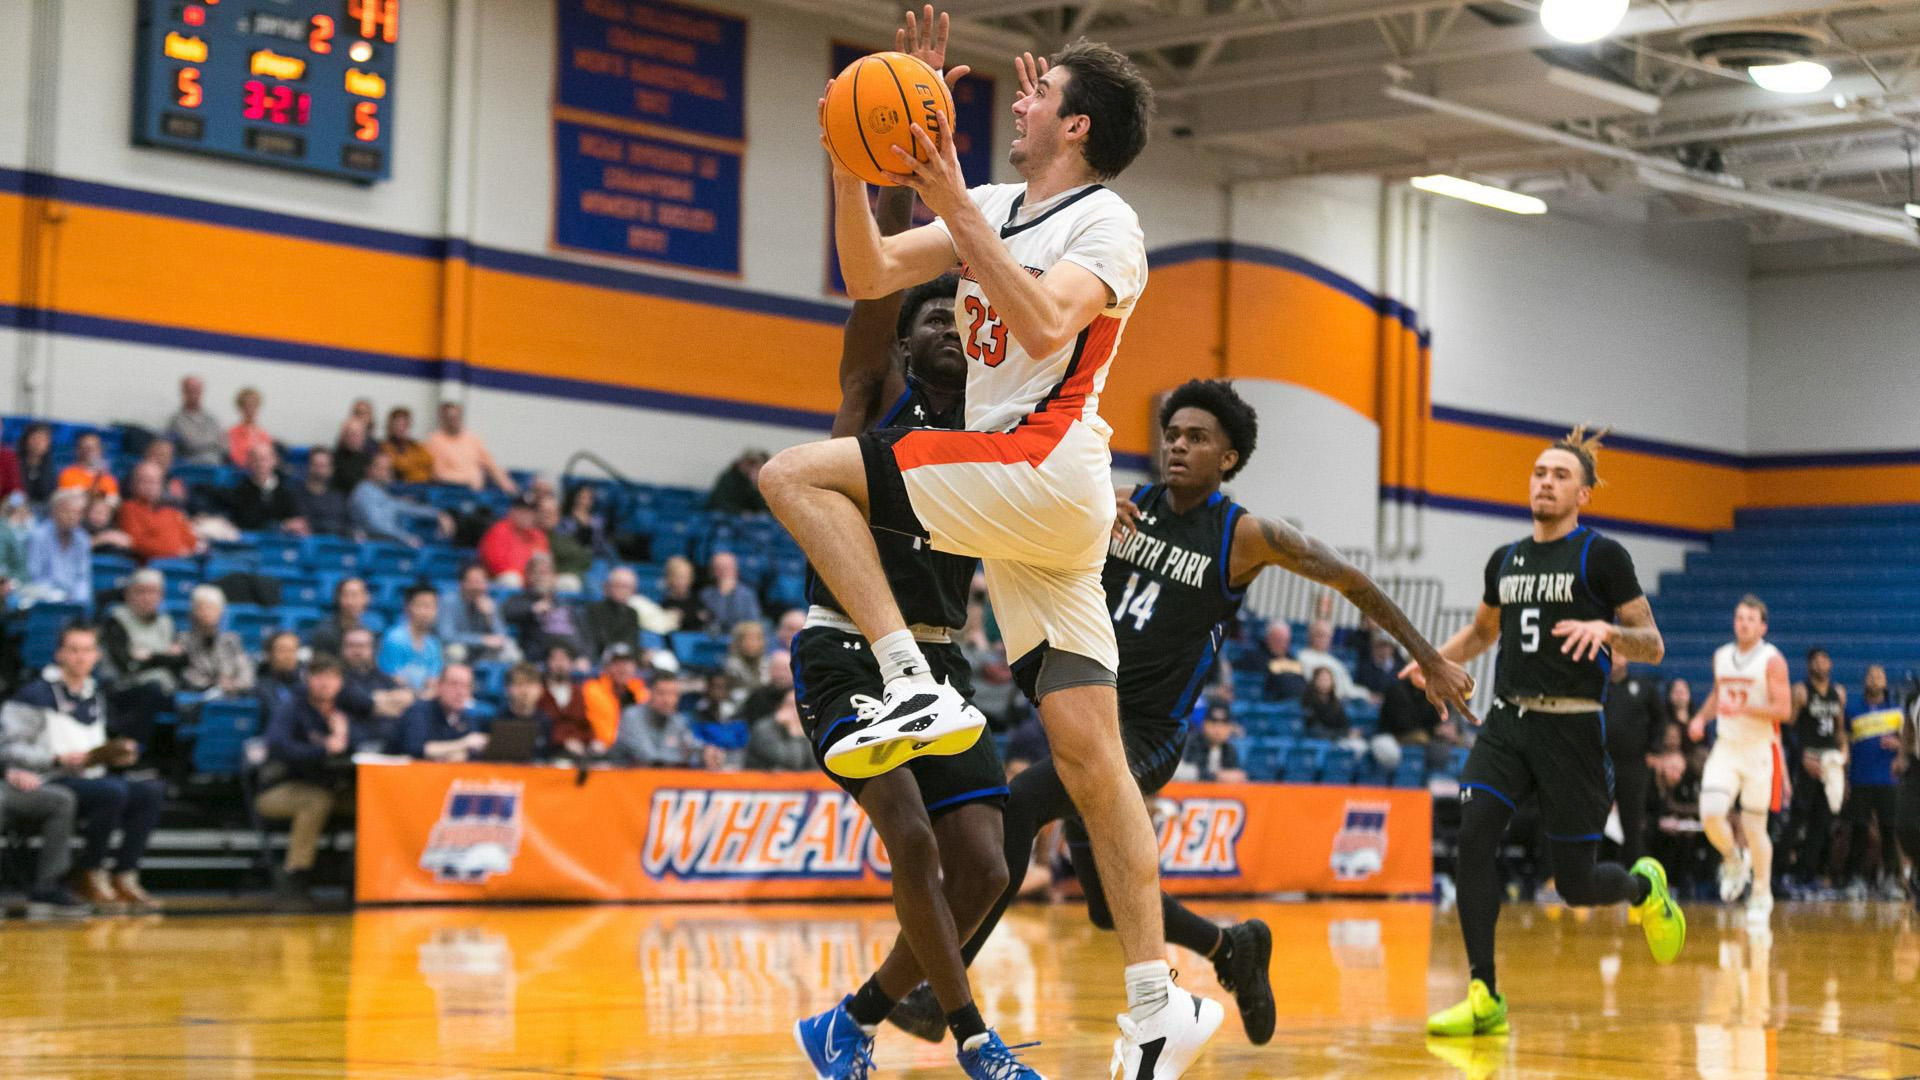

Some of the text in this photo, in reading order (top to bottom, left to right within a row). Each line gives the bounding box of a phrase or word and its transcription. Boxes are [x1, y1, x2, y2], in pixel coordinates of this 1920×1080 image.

[309, 14, 335, 54] 2
[178, 67, 203, 108] 5
[355, 101, 379, 142] 5
[964, 294, 1009, 368] 23
[1161, 545, 1212, 589] PARK
[1537, 572, 1575, 602] PARK
[1113, 572, 1162, 632] 14
[1520, 608, 1541, 653] 5
[641, 789, 893, 880] WHEAT
